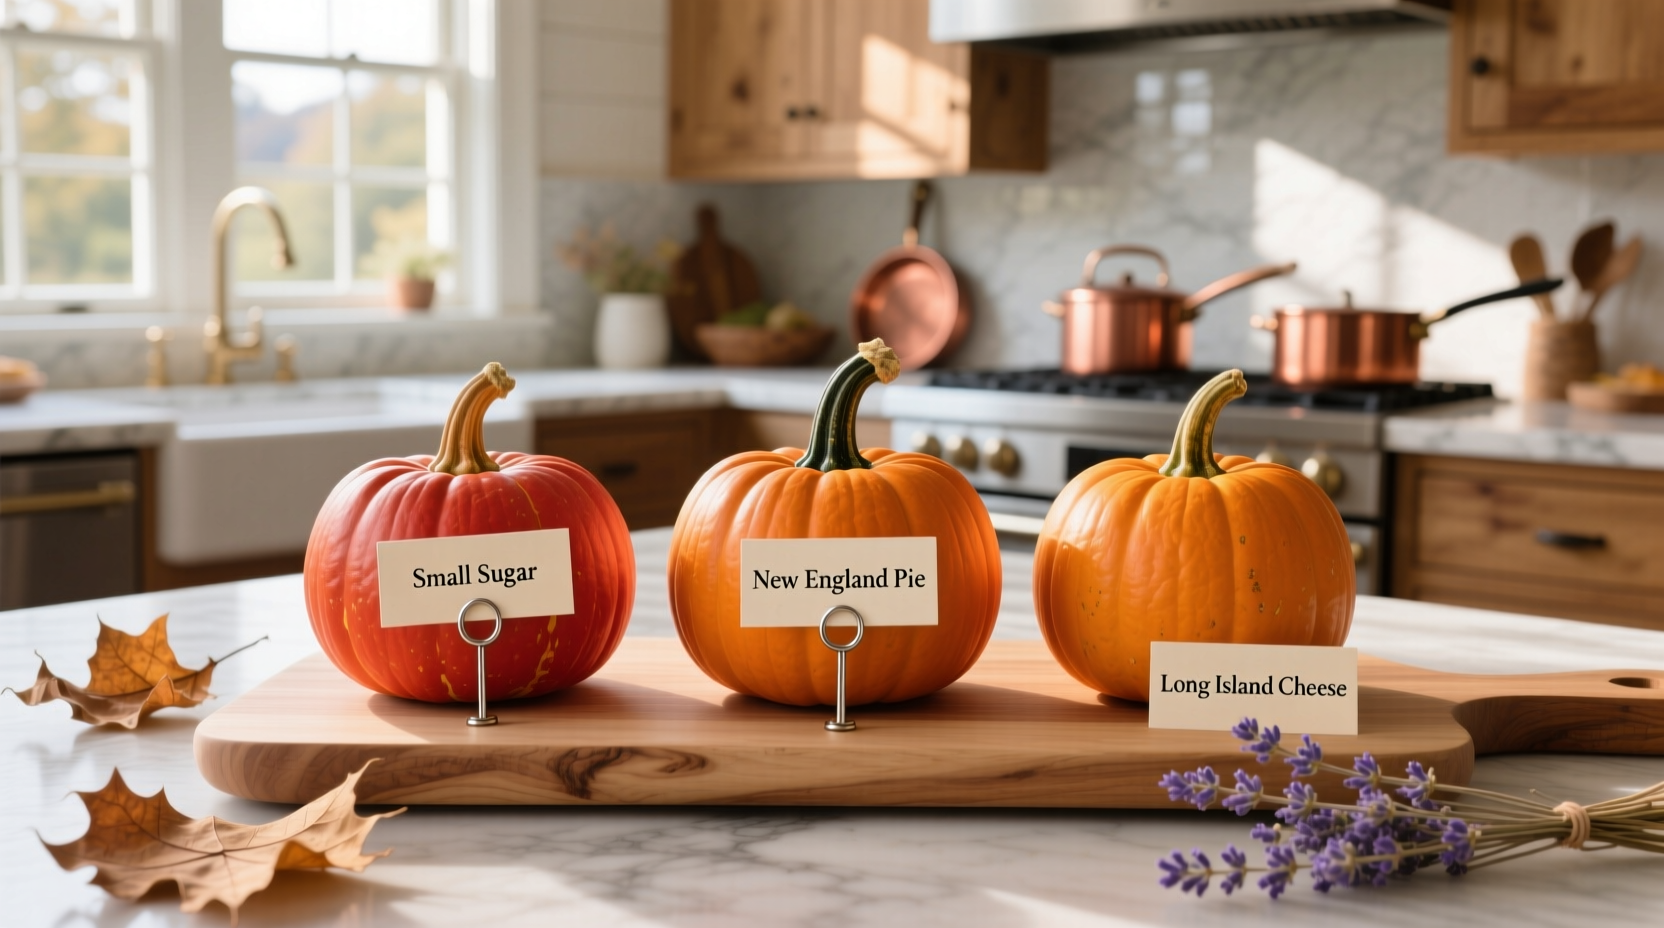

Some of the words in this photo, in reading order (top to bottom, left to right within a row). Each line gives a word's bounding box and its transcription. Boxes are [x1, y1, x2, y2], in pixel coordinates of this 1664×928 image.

[412, 564, 472, 588] Small
[477, 563, 538, 587] Sugar
[752, 569, 799, 590] New
[804, 568, 888, 595] England
[893, 568, 926, 589] Pie
[1160, 674, 1211, 699] Long
[1215, 674, 1274, 696] Island
[1278, 675, 1347, 697] Cheese
